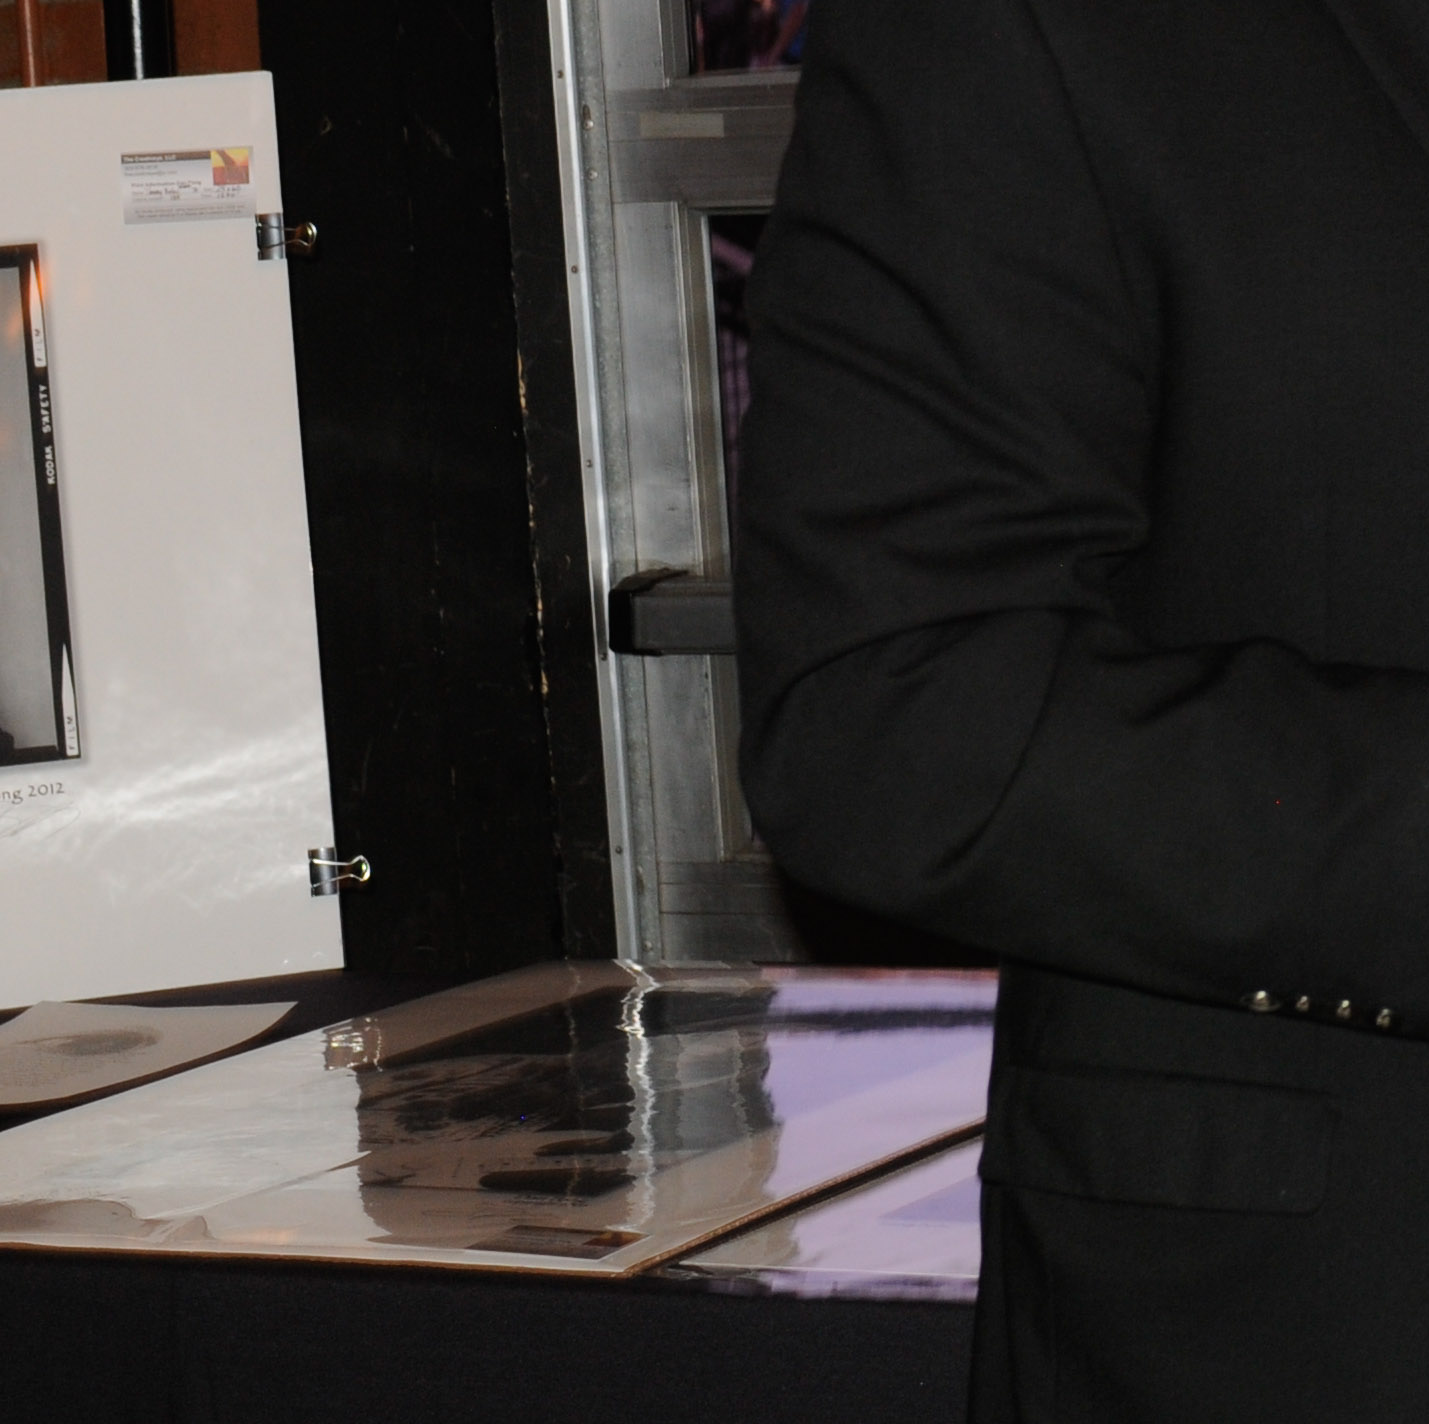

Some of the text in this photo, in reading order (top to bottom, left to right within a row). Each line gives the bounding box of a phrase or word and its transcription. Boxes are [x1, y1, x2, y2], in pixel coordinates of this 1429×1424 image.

[45, 445, 56, 485] KODAK
[66, 716, 76, 750] FILM
[0, 782, 65, 805] ng 2012
